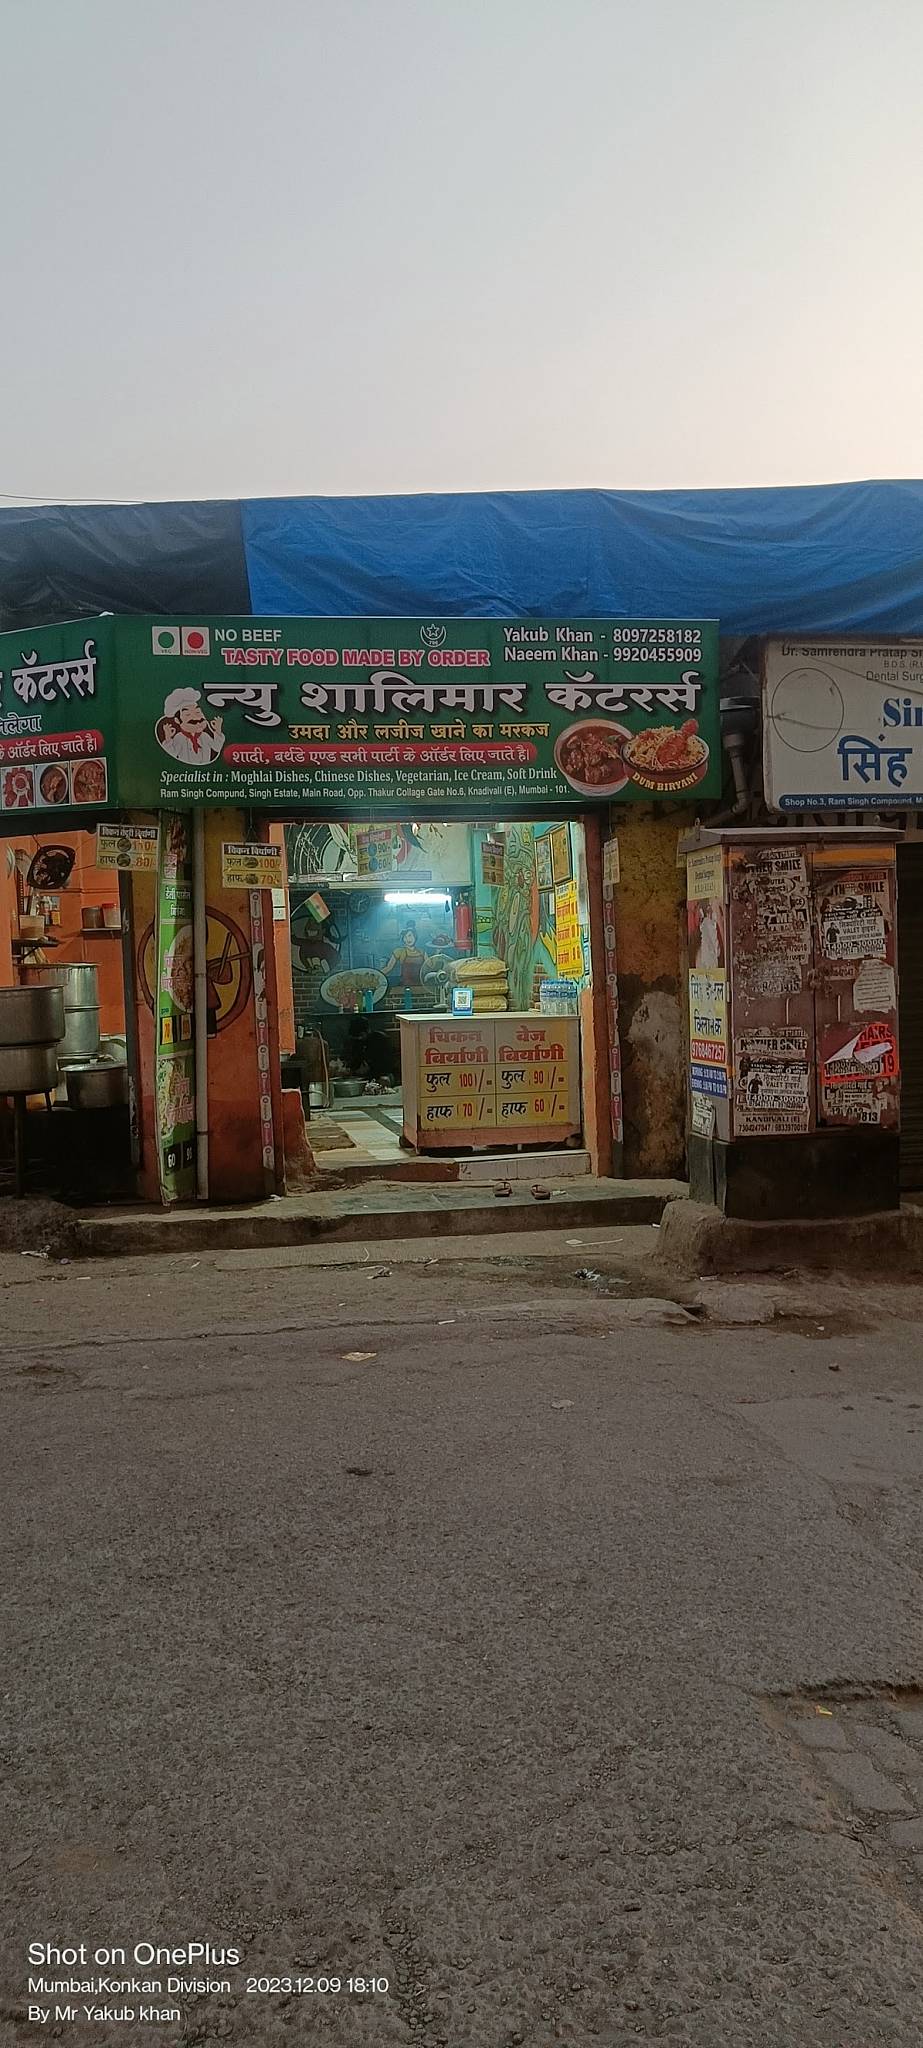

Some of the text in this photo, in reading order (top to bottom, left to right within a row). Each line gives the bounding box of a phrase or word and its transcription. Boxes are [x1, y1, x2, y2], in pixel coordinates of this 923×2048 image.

[215, 629, 282, 643] NO BEEF
[504, 627, 549, 643] Yakub
[556, 627, 593, 643] Khan
[613, 628, 702, 643] 8097258182
[221, 648, 492, 667] TASTY FOOD MADE BY ORDER
[504, 646, 557, 662] Naeem
[561, 646, 599, 662] Khan
[613, 647, 702, 663] 9920455909
[866, 670, 923, 684] Dental Surg
[204, 671, 702, 727] न्यु शालिमार कॅटरर्स
[288, 725, 331, 740] उमदा
[337, 719, 368, 739] और
[430, 719, 466, 739] खाने
[472, 724, 493, 738] का
[499, 723, 550, 738] मरकज
[38, 739, 61, 757] लिए
[61, 735, 84, 753] जाते
[309, 751, 338, 766] एण्ड
[371, 746, 400, 763] पार्टी
[403, 747, 416, 762] के
[420, 746, 456, 762] ऑर्डर
[460, 747, 487, 764] लिए
[488, 746, 515, 761] जाते
[837, 733, 913, 788] सिंह
[160, 770, 210, 784] Specialist
[231, 771, 273, 785] Moghlai
[275, 771, 313, 784] Dishes,
[315, 771, 355, 783] Chinese
[357, 769, 394, 783] Dishes,
[395, 769, 452, 785] Vegetarian,
[454, 769, 469, 781] Ice
[471, 769, 505, 783] Cream,
[507, 768, 527, 780] Soft
[528, 767, 557, 780] Drink
[632, 772, 699, 792] DUM BIRYANI
[160, 789, 179, 798] Ram
[181, 788, 204, 801] Singh
[249, 788, 273, 801] Singh
[274, 788, 301, 800] Estate,
[302, 788, 321, 798] Main
[323, 788, 346, 799] Road,
[347, 788, 367, 800] Opp.
[368, 787, 395, 798] Thakur
[396, 787, 425, 799] Collage
[427, 787, 445, 797] Gate
[468, 785, 503, 797] Knadivali
[518, 784, 549, 796] Mumbai
[785, 798, 805, 808] Shop
[828, 797, 846, 806] Ram
[847, 796, 870, 807] Singh
[100, 839, 117, 850] फुल
[99, 855, 117, 865] हाफ
[774, 860, 801, 872] SMILE
[857, 882, 885, 894] SMILE
[428, 1025, 546, 1044] चिकन वेज
[426, 1072, 452, 1093] फुल
[501, 1069, 526, 1090] फुल
[427, 1104, 454, 1122] हाफ
[501, 1101, 528, 1119] हाफ
